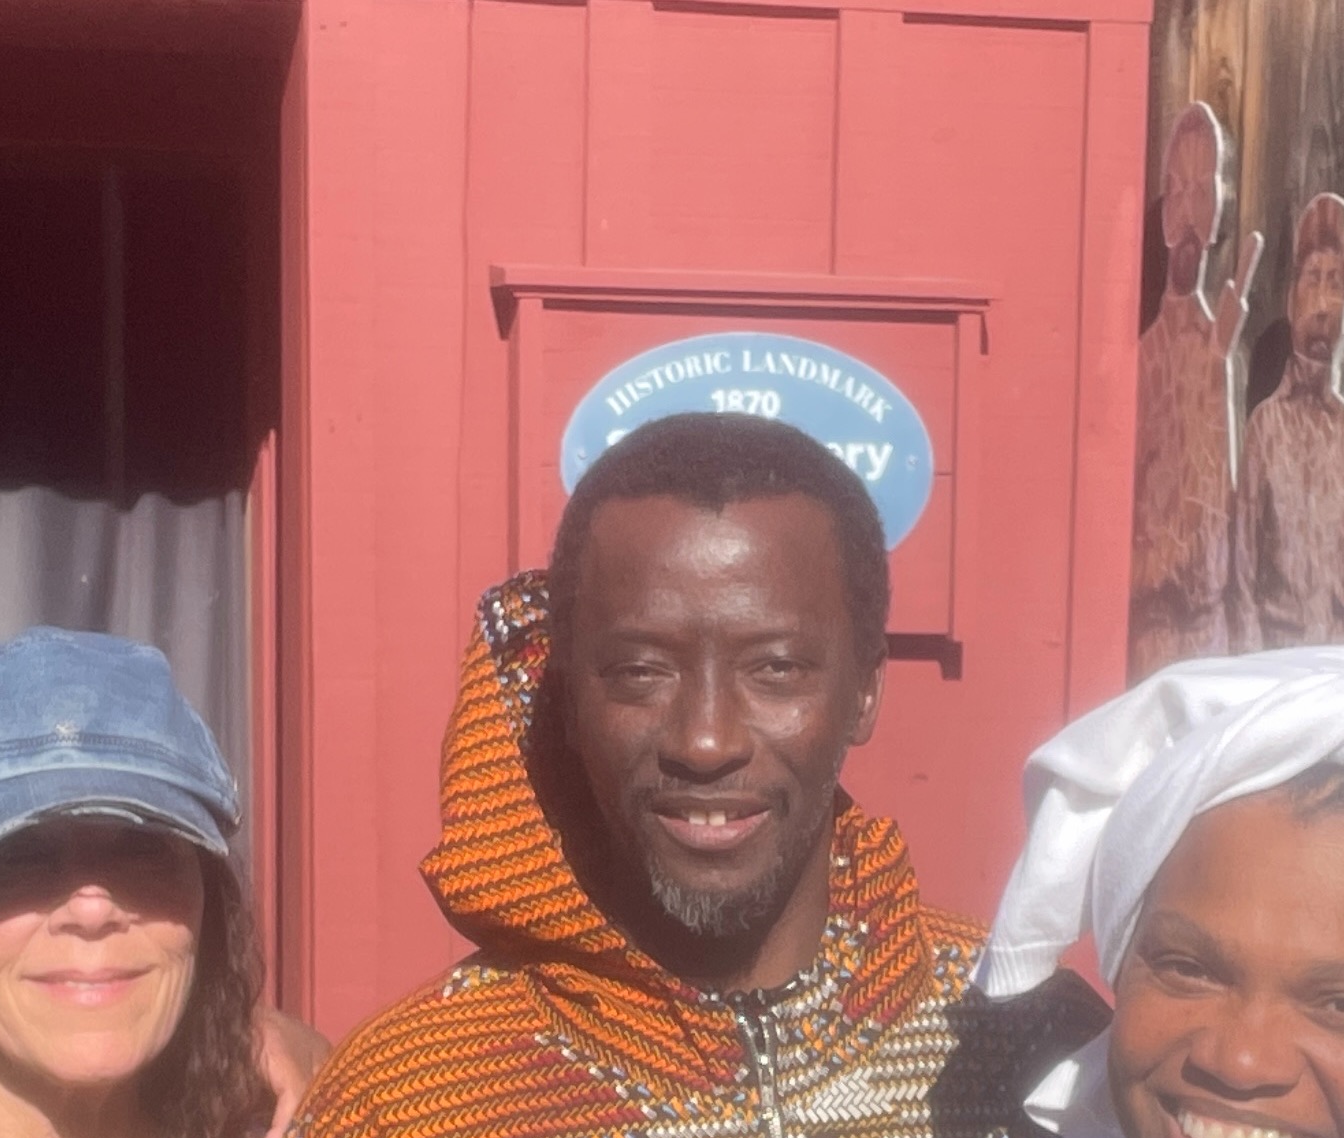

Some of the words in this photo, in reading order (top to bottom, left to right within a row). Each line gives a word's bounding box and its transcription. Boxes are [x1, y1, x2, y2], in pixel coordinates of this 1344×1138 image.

[606, 351, 732, 416] HISTORIC
[742, 349, 893, 423] LANDMARK
[711, 388, 781, 419] 1870
